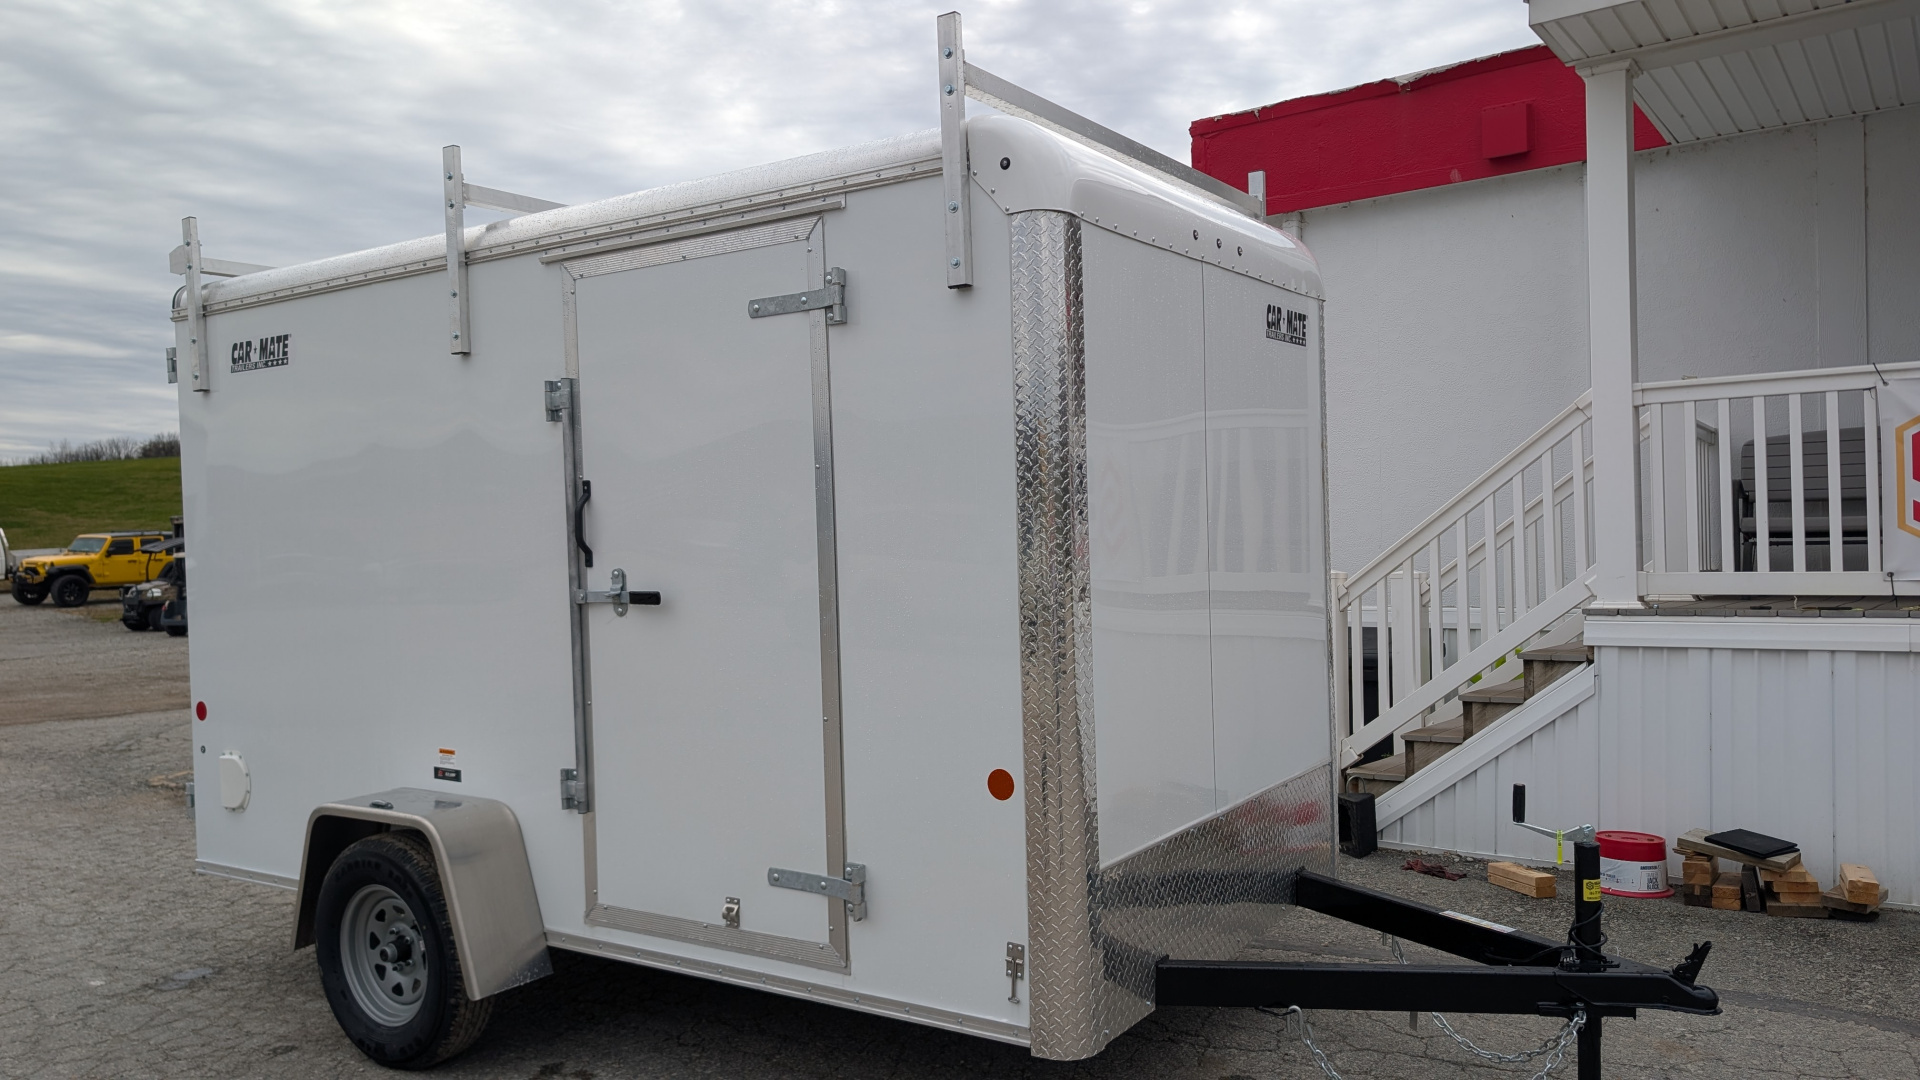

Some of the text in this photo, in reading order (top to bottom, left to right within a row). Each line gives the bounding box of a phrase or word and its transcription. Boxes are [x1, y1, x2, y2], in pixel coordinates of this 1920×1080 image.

[1266, 303, 1307, 338] CAR MATE
[231, 333, 289, 365] CAR MATE
[232, 362, 256, 373] TRAILERS
[1646, 877, 1659, 885] JACK
